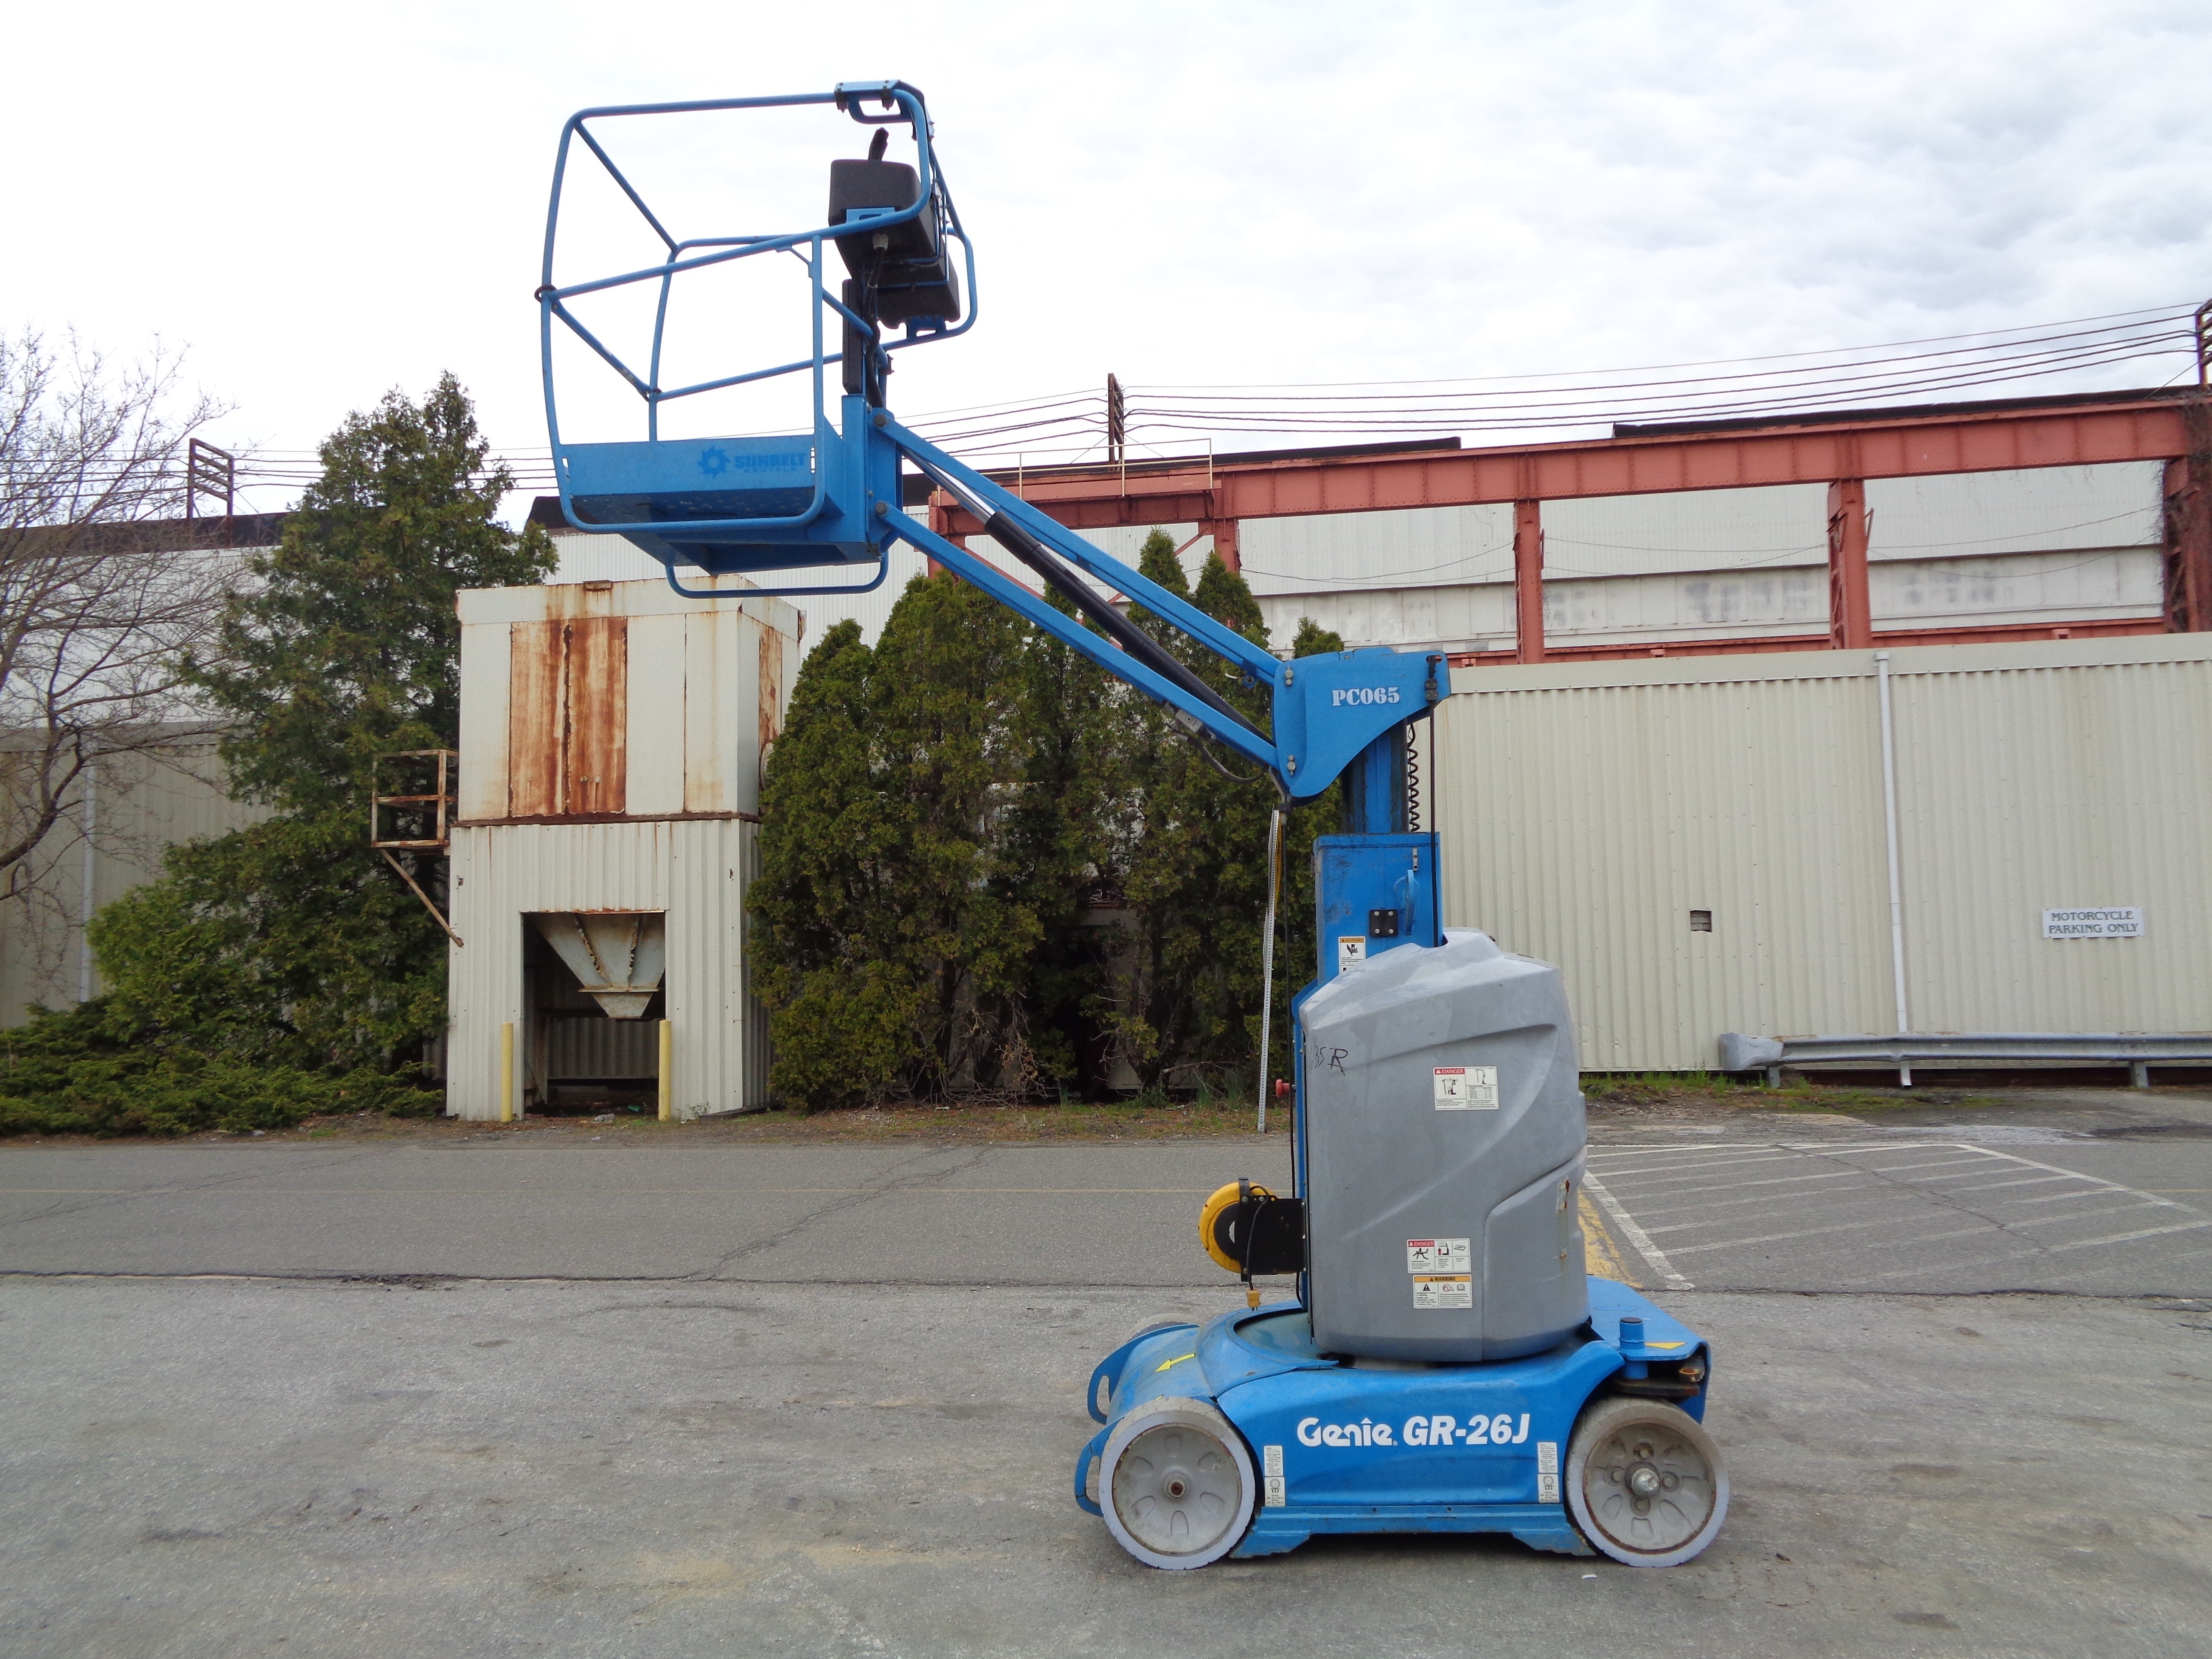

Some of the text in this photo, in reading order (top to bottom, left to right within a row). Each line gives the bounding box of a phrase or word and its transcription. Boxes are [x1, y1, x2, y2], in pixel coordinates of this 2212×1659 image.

[1332, 687, 1400, 707] PC065
[2051, 911, 2133, 921] MOTORCYCLE
[2048, 923, 2139, 934] PARKING ONLY
[1297, 1413, 1531, 1447] Genie GR-26J
